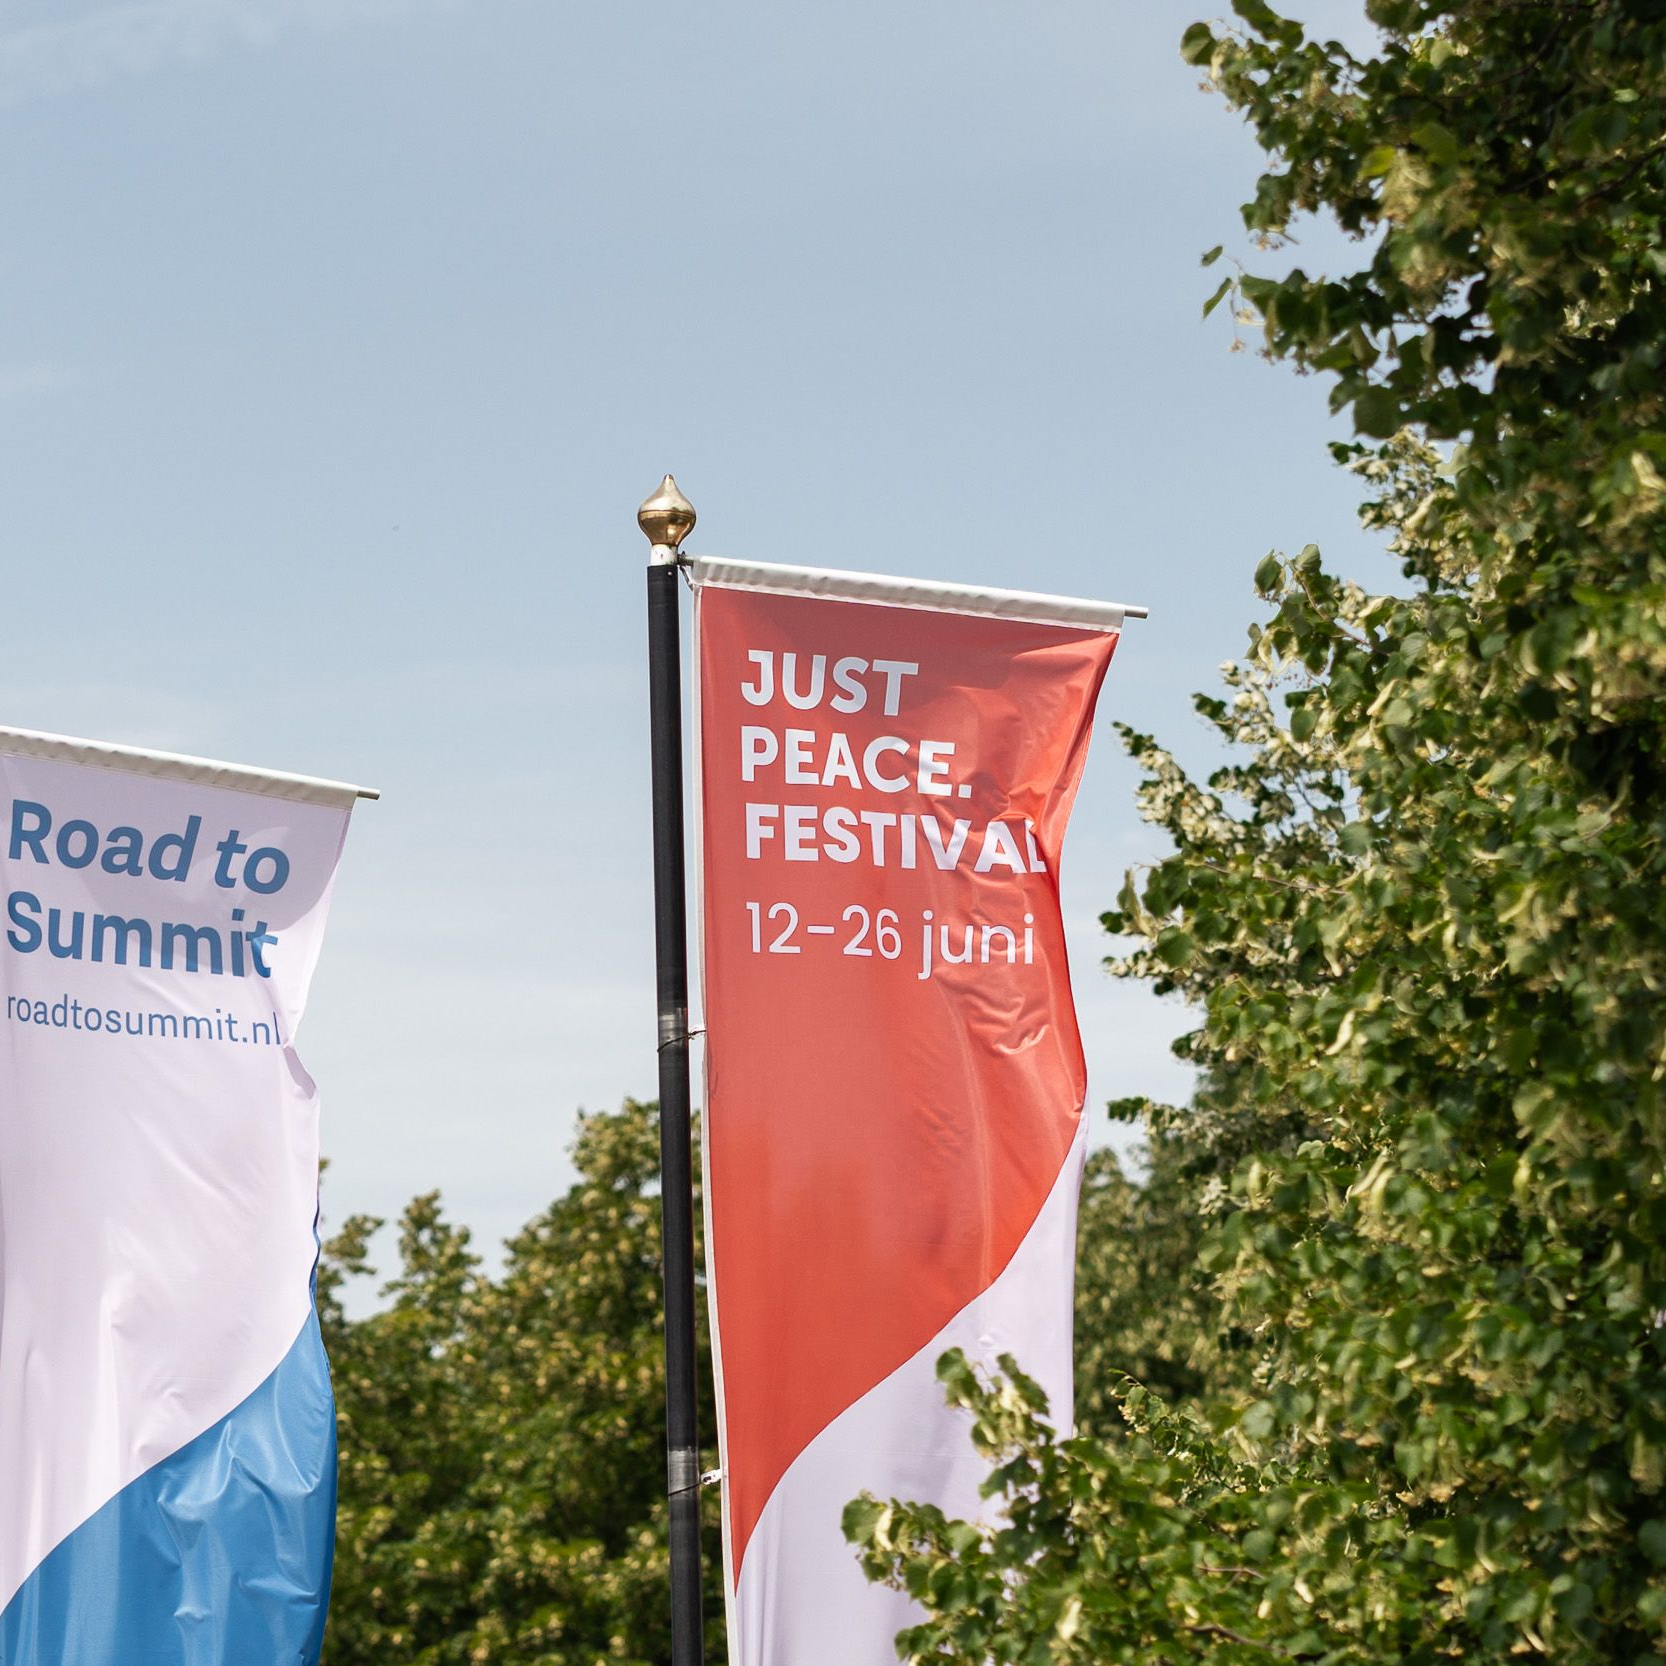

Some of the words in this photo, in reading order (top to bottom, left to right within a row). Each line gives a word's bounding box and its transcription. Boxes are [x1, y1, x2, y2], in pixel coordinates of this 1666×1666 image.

[741, 650, 919, 716] JUST
[741, 726, 972, 798] PEACE.
[9, 799, 202, 882] Road
[215, 830, 290, 894] to
[746, 803, 1048, 874] FESTIVAL
[7, 891, 278, 978] Summit
[918, 910, 1035, 980] juni
[7, 993, 281, 1045] roadtosummit.nl
